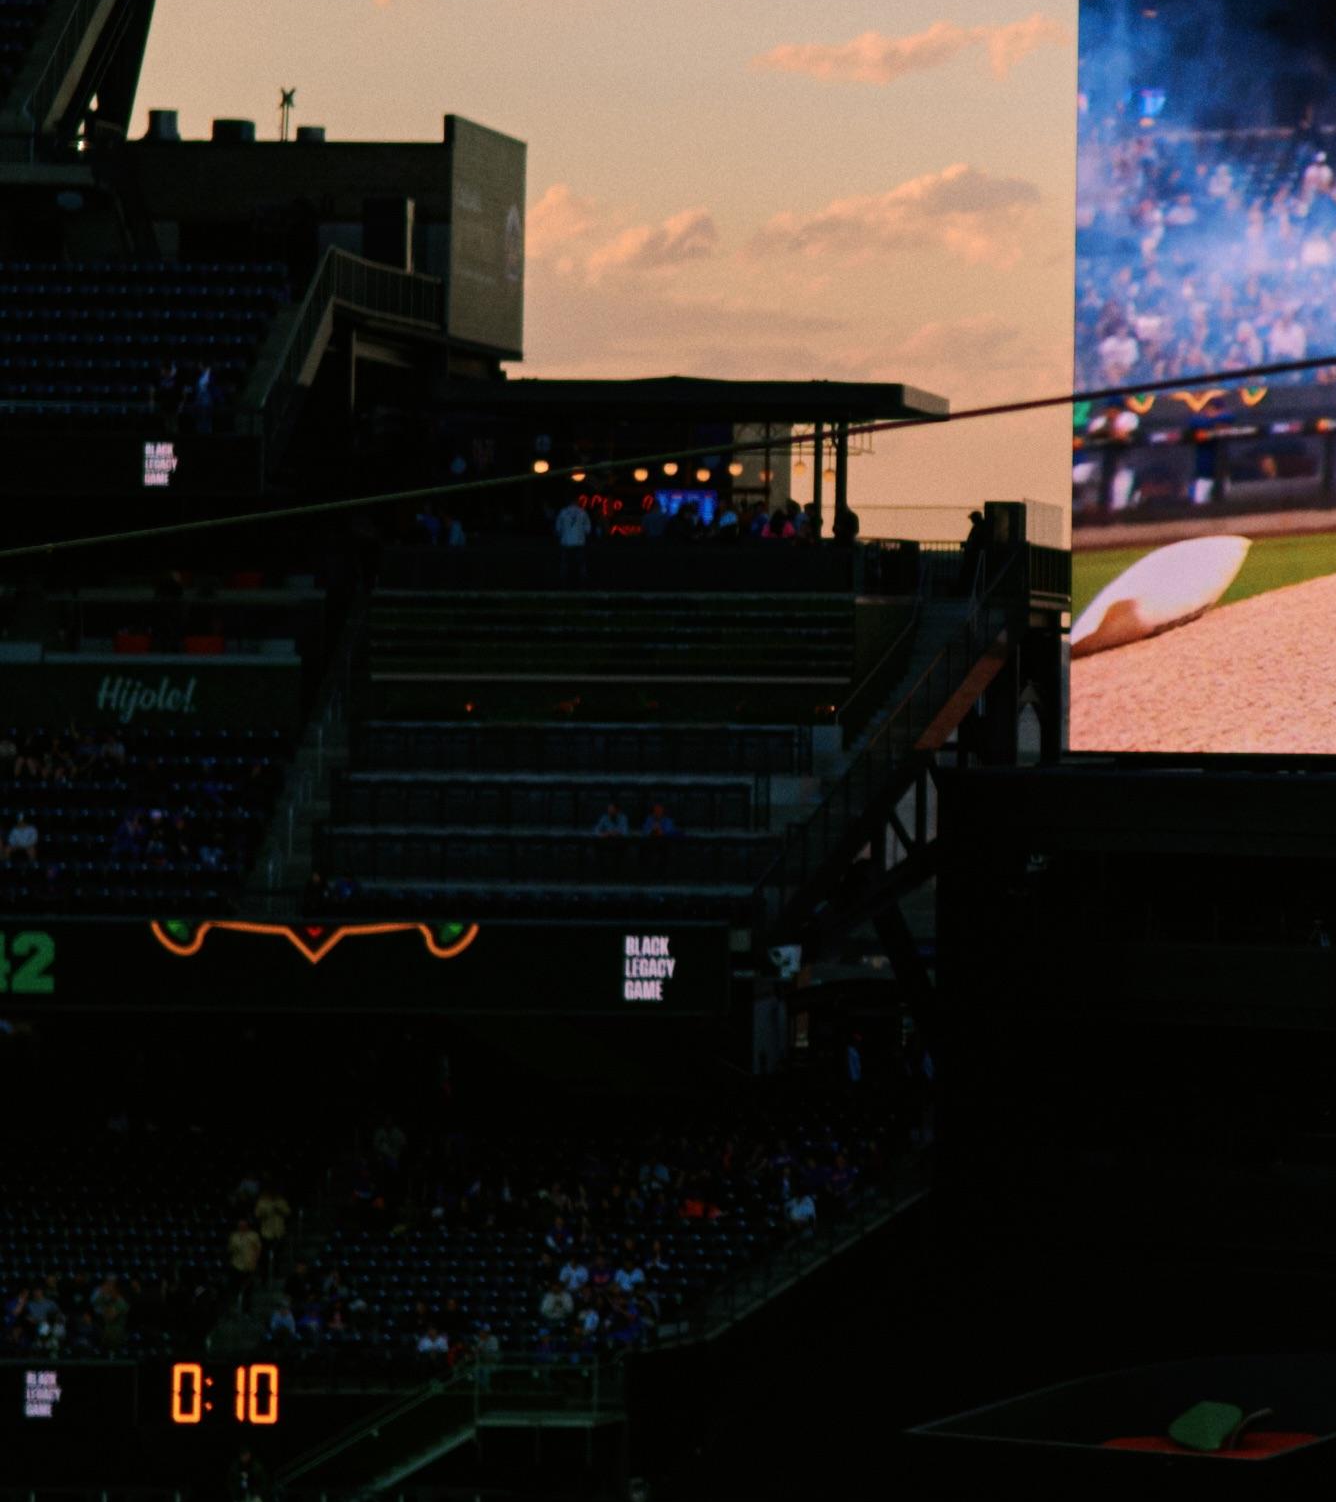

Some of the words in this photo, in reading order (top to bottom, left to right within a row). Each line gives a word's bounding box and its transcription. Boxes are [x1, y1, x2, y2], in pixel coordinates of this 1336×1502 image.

[625, 935, 670, 956] BLACK
[625, 957, 676, 979] LEGACY
[624, 979, 664, 1001] GAME
[171, 1362, 279, 1425] 0:10
